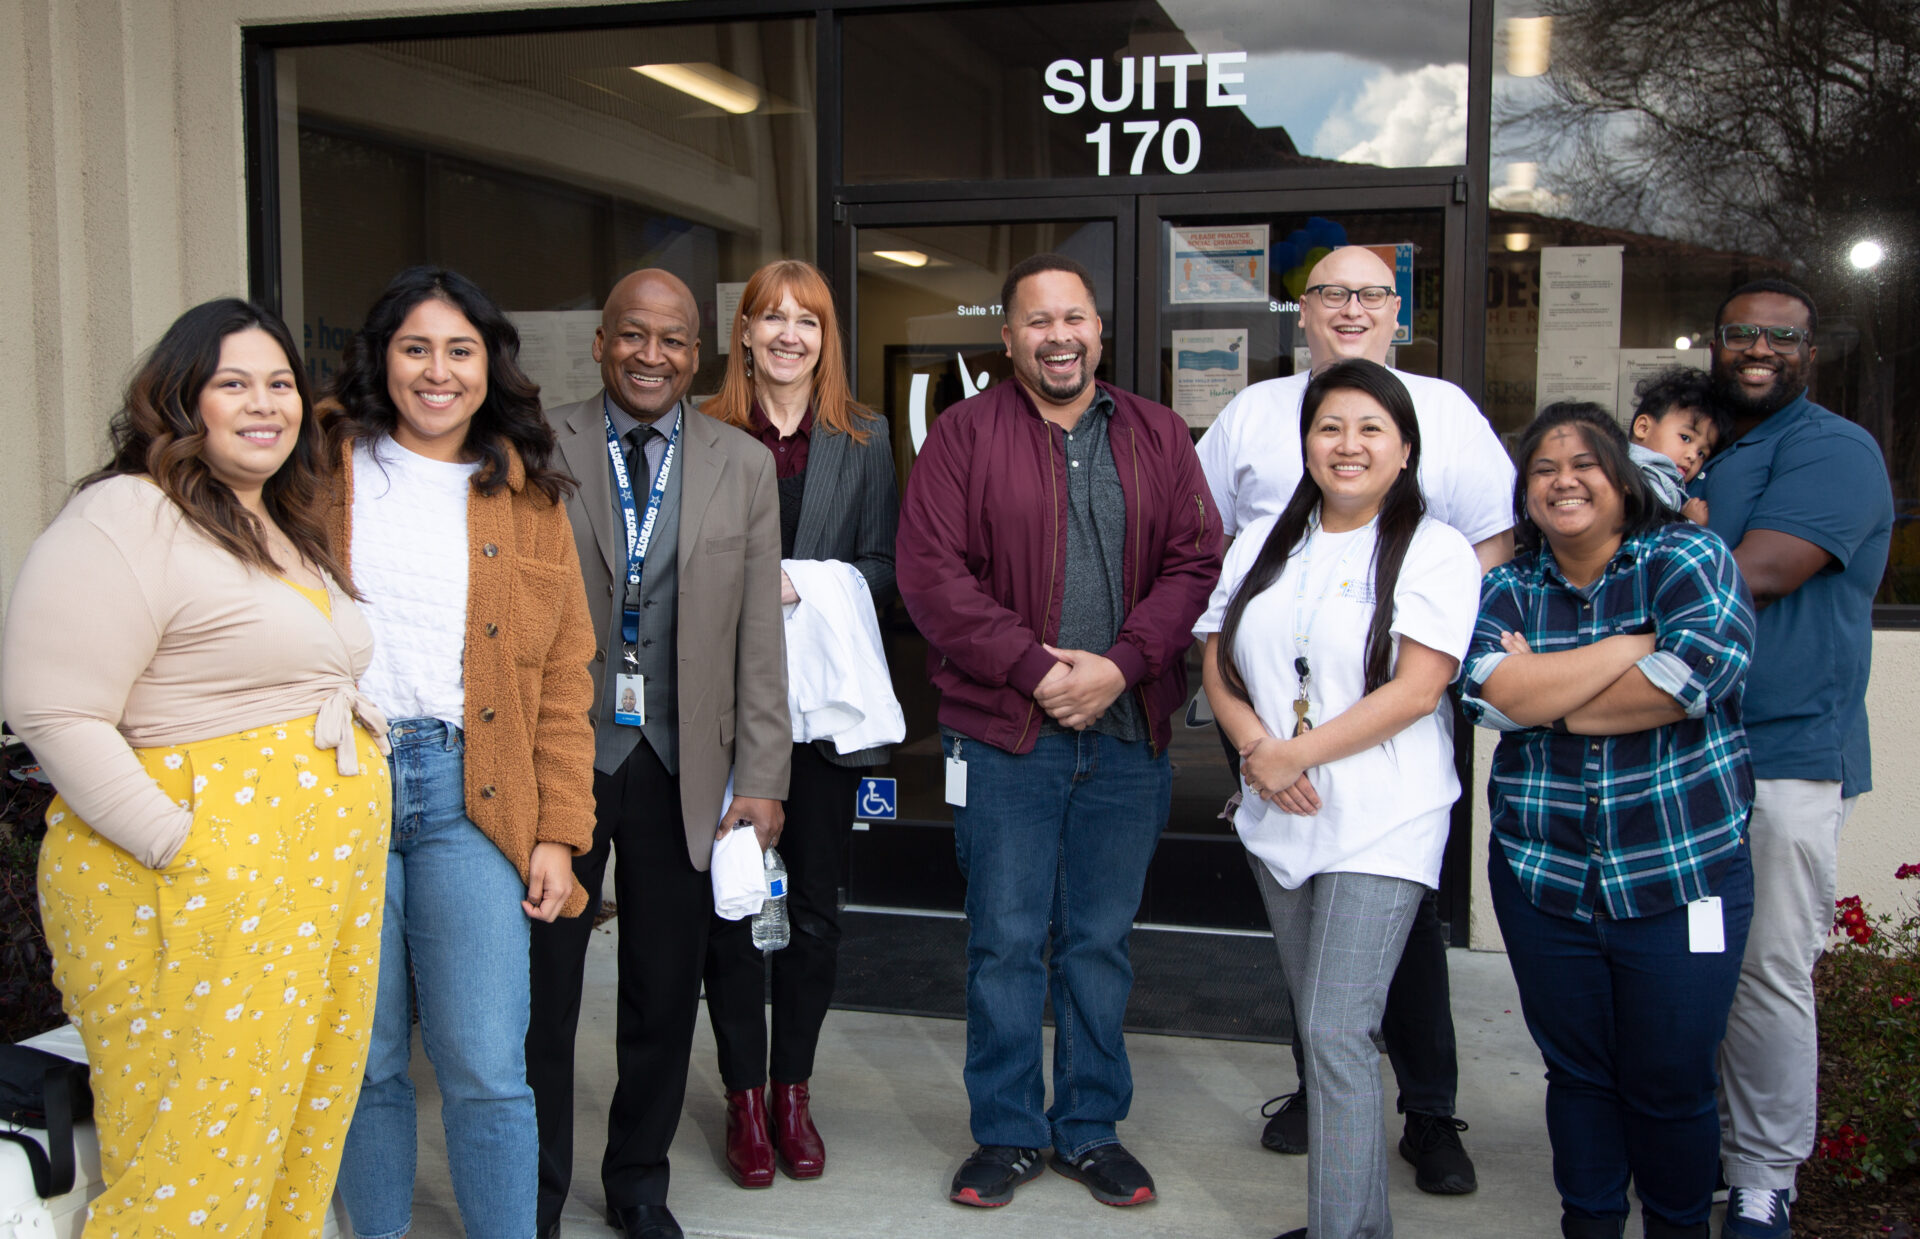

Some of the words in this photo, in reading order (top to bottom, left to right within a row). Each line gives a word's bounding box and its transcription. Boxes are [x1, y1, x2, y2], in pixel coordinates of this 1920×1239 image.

[1043, 51, 1248, 114] SUITE
[1086, 119, 1201, 176] 170
[1190, 232, 1216, 240] PLEASE
[1217, 231, 1250, 239] PRACTICE
[1213, 238, 1254, 246] DISTANCING
[957, 305, 987, 316] Suite
[989, 304, 1005, 315] 17
[1269, 301, 1300, 313] Suite
[608, 440, 629, 489] COWBOYS
[656, 444, 676, 492] COWBOYS
[635, 507, 658, 558] COWBOYS
